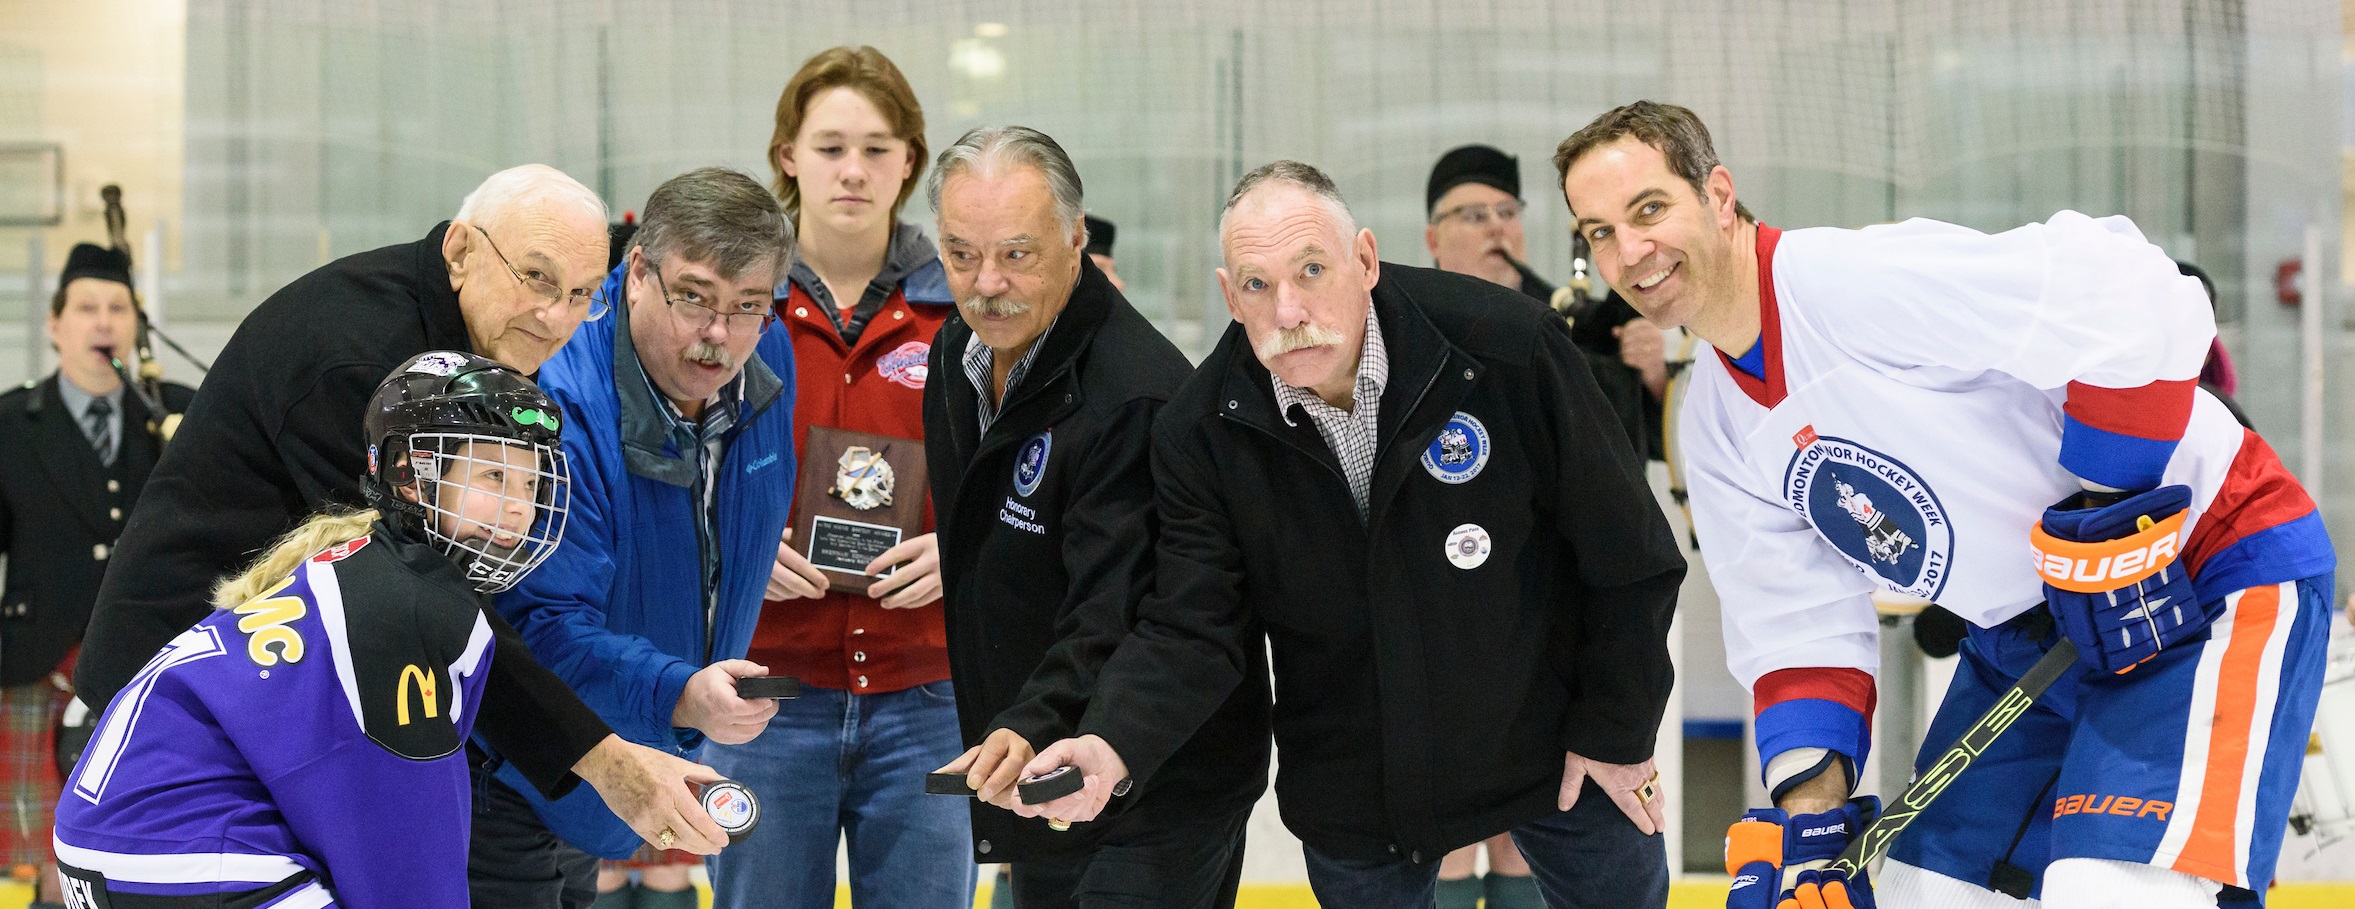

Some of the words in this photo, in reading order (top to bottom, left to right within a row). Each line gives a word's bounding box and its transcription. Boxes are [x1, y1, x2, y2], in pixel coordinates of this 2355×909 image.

[1468, 419, 1486, 439] HOCKEY
[1469, 463, 1482, 475] 2017
[1856, 452, 1915, 491] HOCKEY
[1911, 490, 1942, 526] WEEK
[1000, 508, 1045, 535] Chairperson
[1005, 496, 1036, 520] Honorary
[1923, 550, 1944, 589] 2017
[2030, 531, 2178, 582] BAUER
[2052, 794, 2175, 822] BAUER
[1801, 822, 1848, 838] BAUER
